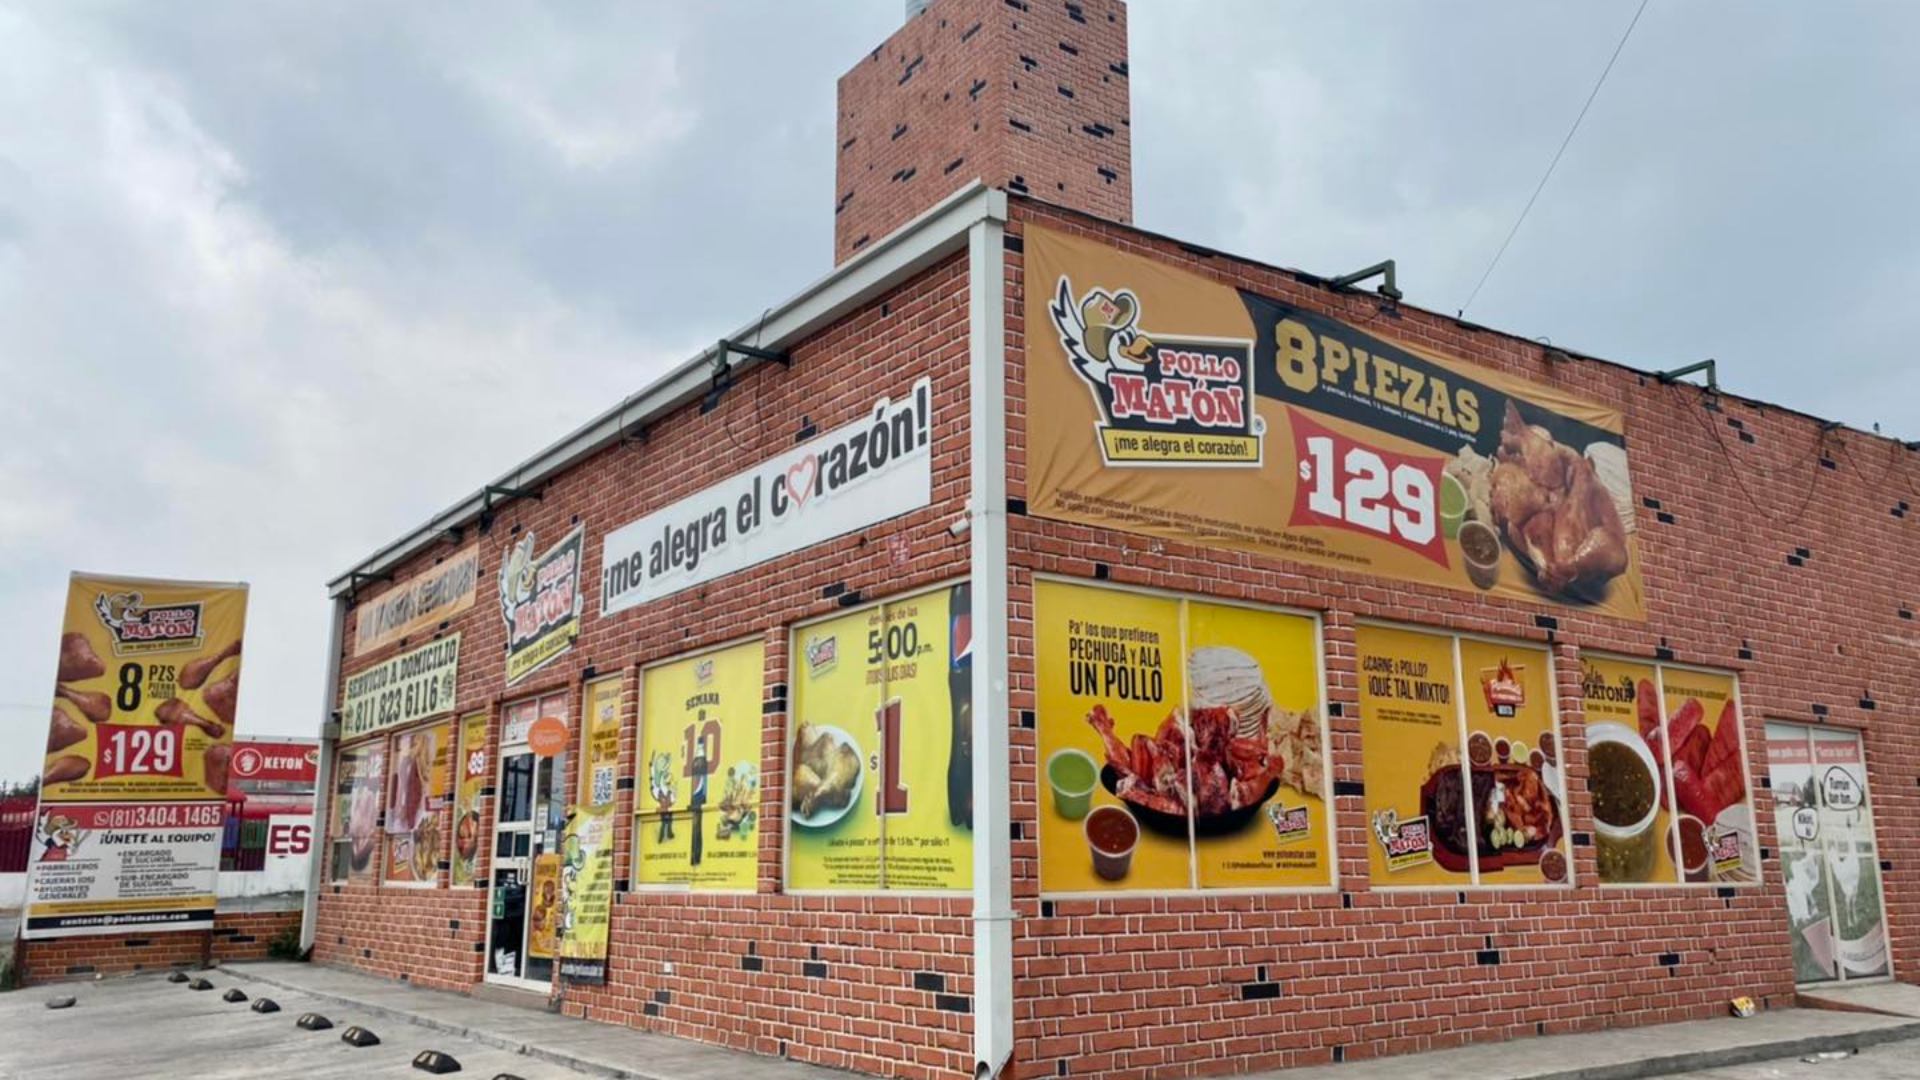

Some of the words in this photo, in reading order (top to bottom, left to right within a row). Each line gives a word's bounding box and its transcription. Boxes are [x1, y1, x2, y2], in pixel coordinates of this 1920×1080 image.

[1160, 350, 1239, 381] POLLO
[1275, 317, 1318, 393] 8
[1319, 334, 1481, 434] PIEZAS
[1109, 374, 1243, 427] MATÓN
[1142, 436, 1180, 456] alegra
[1183, 438, 1195, 453] el
[1197, 440, 1248, 457] corazón!
[1299, 436, 1436, 545] $129
[649, 505, 727, 571] alegra
[736, 475, 761, 535] el
[150, 609, 194, 621] POLLO
[1085, 621, 1099, 637] los
[1101, 625, 1117, 640] que
[1119, 627, 1160, 645] prefieren
[347, 665, 388, 700] SERVICIO
[389, 661, 397, 684] A
[401, 638, 457, 681] DOMICILIO
[1069, 637, 1128, 664] PECHUGA
[1130, 648, 1137, 665] Y
[1139, 645, 1162, 669] ALA
[117, 662, 143, 712] 8
[1070, 660, 1098, 696] UN
[1105, 664, 1163, 703] POLLO
[1394, 678, 1413, 700] TAL
[1414, 682, 1450, 705] MIXTO!
[355, 697, 375, 733] 811
[378, 688, 402, 726] 823
[405, 675, 438, 718] 6116
[104, 729, 175, 773] $129
[100, 830, 149, 845] ¡ÚNETE
[150, 834, 165, 844] AL
[167, 832, 216, 844] EQUIPO!
